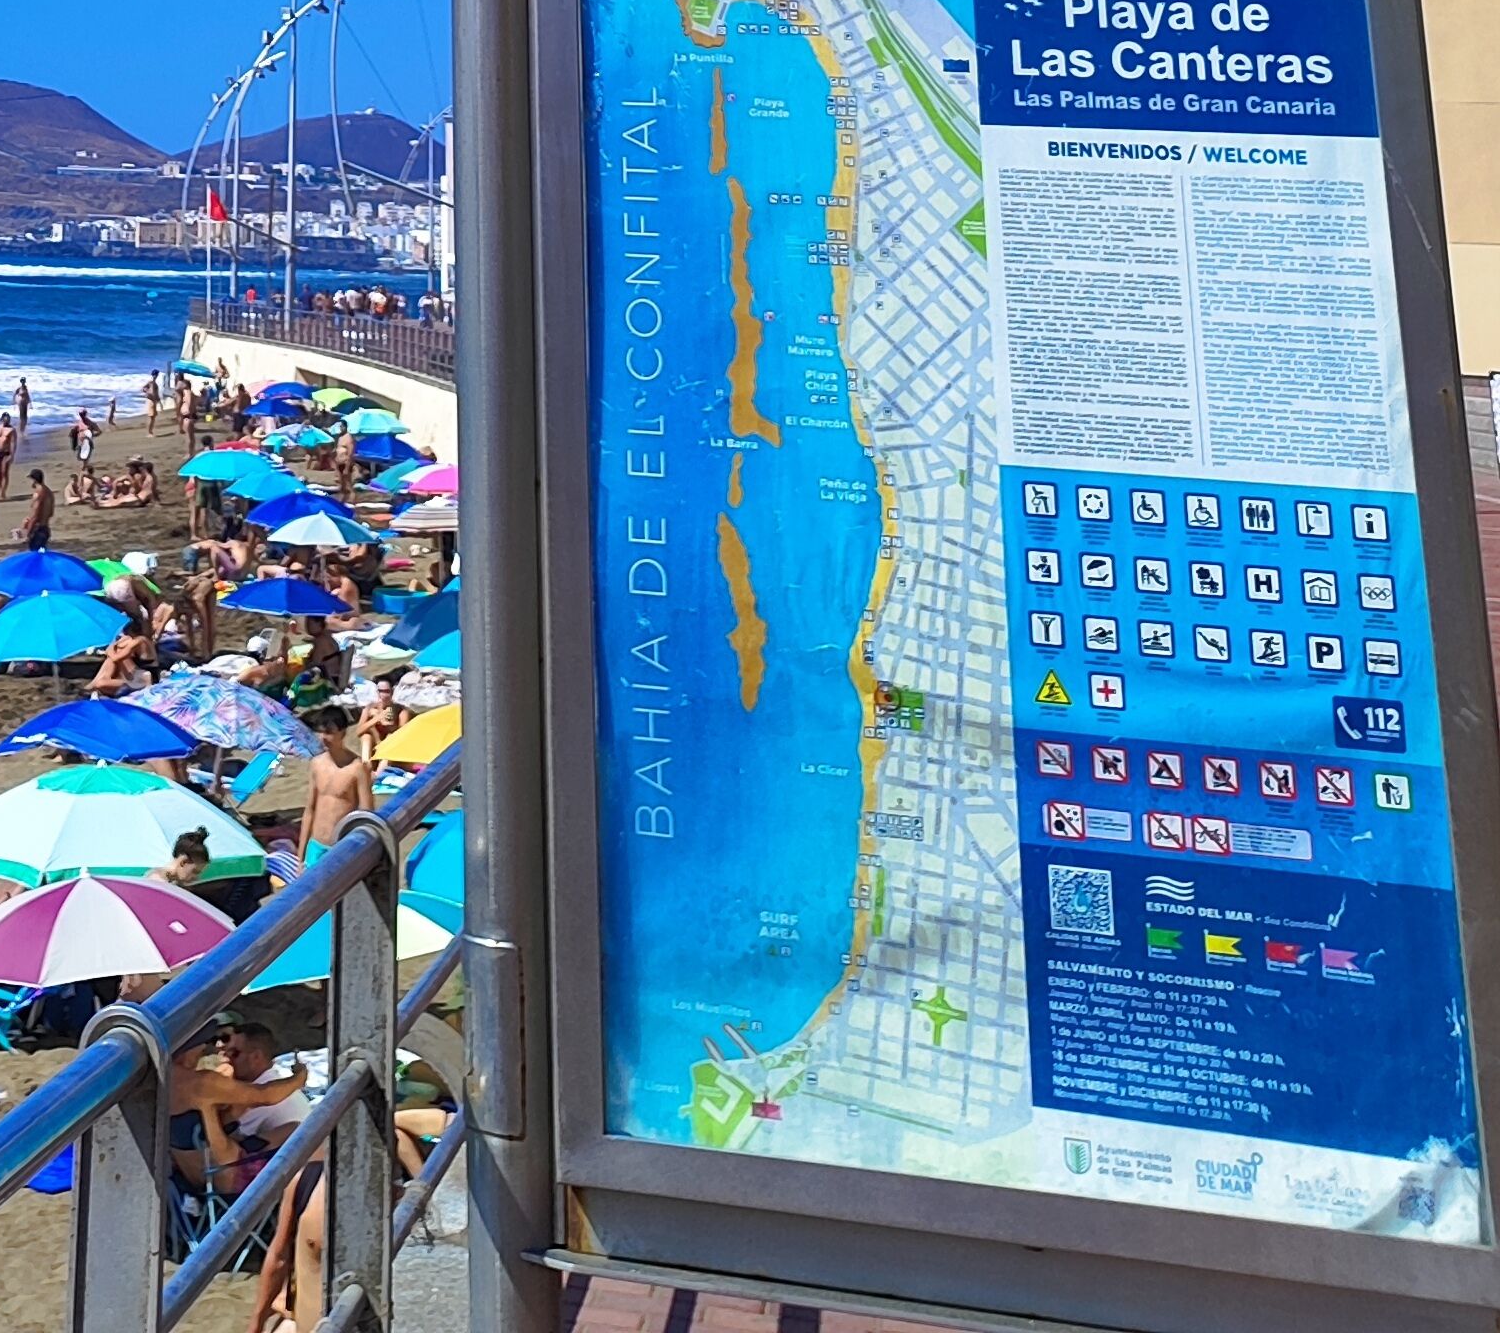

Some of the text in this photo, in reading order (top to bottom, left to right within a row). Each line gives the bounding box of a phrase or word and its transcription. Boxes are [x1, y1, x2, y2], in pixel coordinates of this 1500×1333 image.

[675, 53, 734, 63] La Puntilla
[1011, 39, 1333, 84] Las Canteras
[754, 98, 784, 108] Playa
[1014, 89, 1336, 116] Las Palmas de Gran Canaria
[749, 109, 789, 117] Grande
[1047, 140, 1308, 166] BIENVENIDOS / WELCOME
[710, 437, 723, 447] La
[621, 86, 674, 838] BAHÍA DE EL CONFITAL
[1363, 707, 1401, 731] 112
[759, 911, 799, 925] SURF
[1146, 901, 1195, 916] ESTADO
[1198, 907, 1223, 919] DEL
[1225, 910, 1253, 923] MAR
[758, 926, 800, 940] AREA
[1047, 959, 1132, 979] SALVAMENTO
[1135, 970, 1144, 980] Y
[1148, 972, 1235, 991] SOCORRISMO
[1195, 1159, 1252, 1179] CIUDAD
[1197, 1175, 1253, 1194] DE MAR
